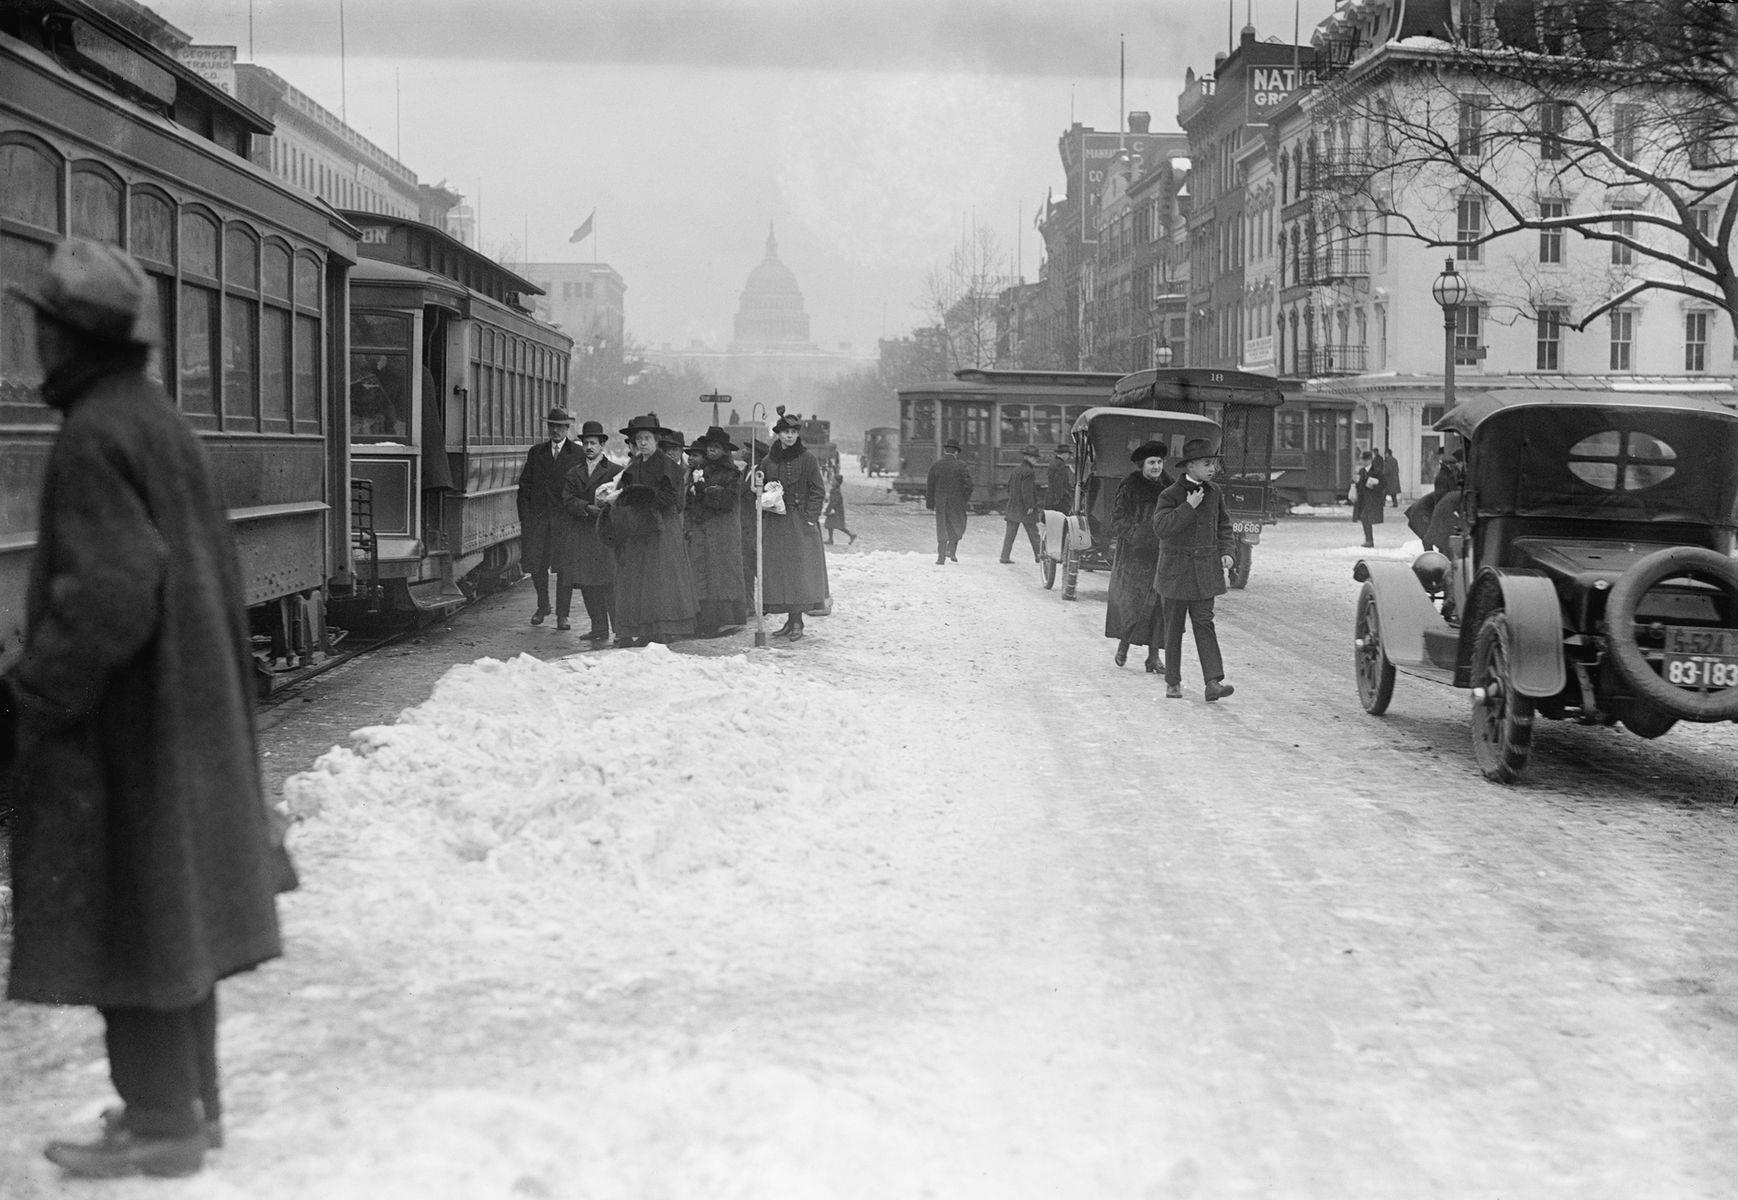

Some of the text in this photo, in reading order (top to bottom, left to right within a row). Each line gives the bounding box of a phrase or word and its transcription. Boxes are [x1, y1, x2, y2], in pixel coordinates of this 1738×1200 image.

[183, 61, 229, 69] TRAUSS
[1211, 373, 1223, 382] 18
[1669, 661, 1738, 686] 83-183
